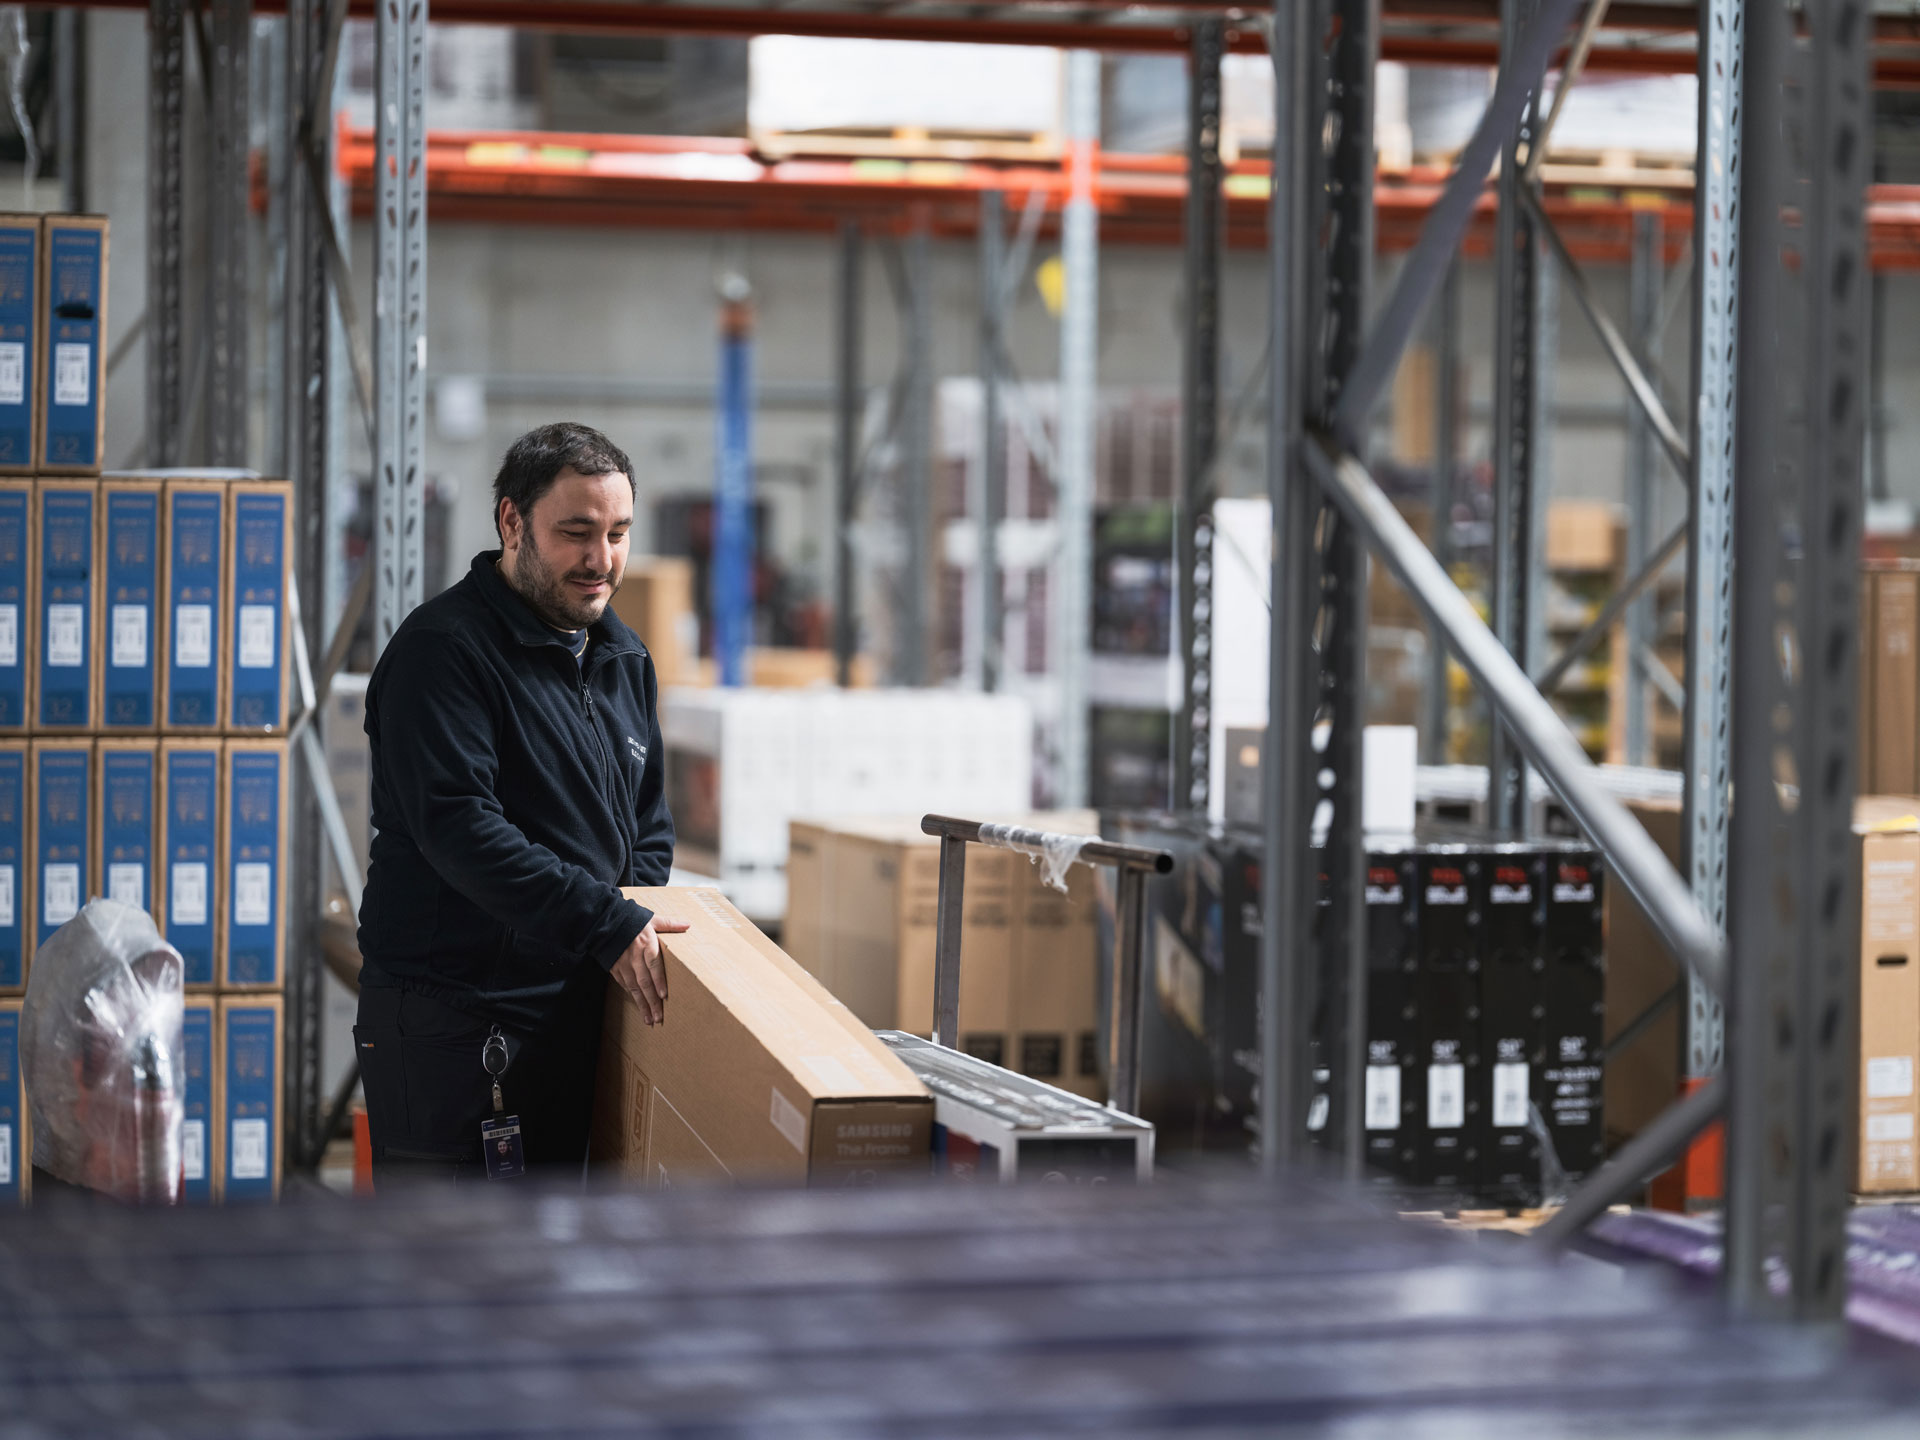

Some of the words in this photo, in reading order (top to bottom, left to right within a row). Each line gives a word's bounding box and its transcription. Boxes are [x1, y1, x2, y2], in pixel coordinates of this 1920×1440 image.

[836, 1124, 912, 1138] SAMSUNG
[836, 1144, 863, 1156] The
[864, 1143, 911, 1156] Frame
